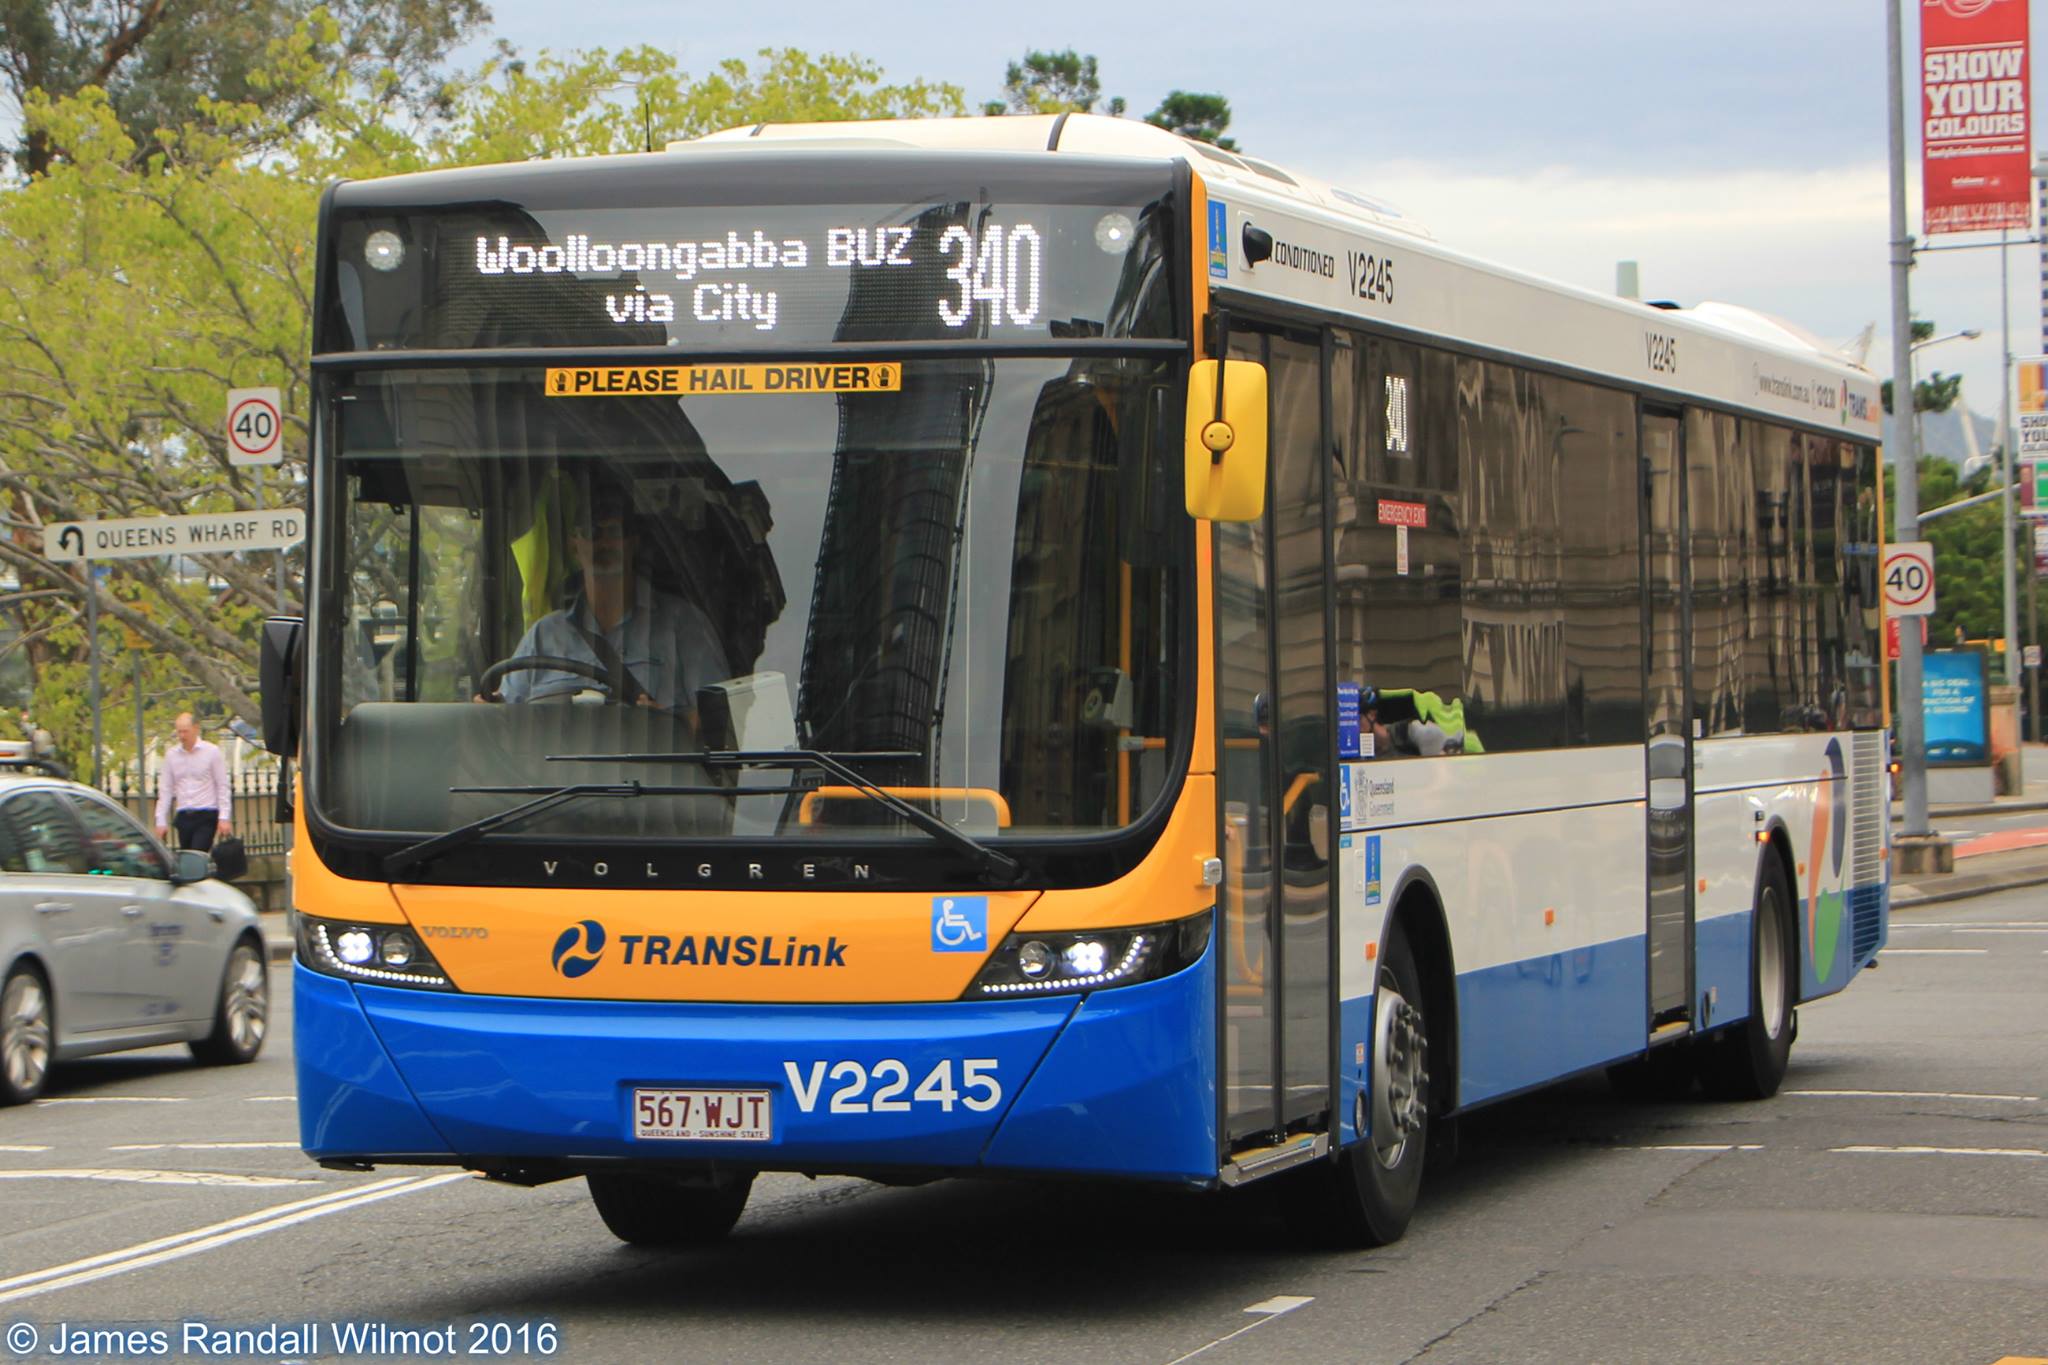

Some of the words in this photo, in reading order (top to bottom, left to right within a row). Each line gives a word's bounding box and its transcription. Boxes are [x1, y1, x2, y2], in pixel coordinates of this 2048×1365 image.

[1925, 48, 2024, 83] SHOW
[1926, 80, 2024, 116] YOUR
[1926, 113, 2025, 139] COLOURS
[477, 230, 807, 280] Woolloongabba
[828, 227, 912, 266] BUZ
[1275, 241, 1334, 278] CONDITIONED
[939, 224, 1040, 326] 340
[1348, 250, 1394, 304] V2245
[606, 285, 674, 322] via
[694, 283, 777, 329] City
[1645, 331, 1676, 374] V2245
[574, 370, 678, 392] PLEASE
[689, 368, 753, 391] HAIL
[764, 366, 869, 389] DRIVER
[235, 412, 272, 438] 40
[97, 526, 176, 549] QUEENS
[188, 521, 258, 544] WHARF
[272, 518, 299, 538] RD
[1886, 566, 1924, 591] 40
[544, 861, 869, 879] VOLGREN
[420, 926, 489, 939] VOLVO
[619, 935, 848, 967] TRANSLink
[783, 1059, 1002, 1113] V2245
